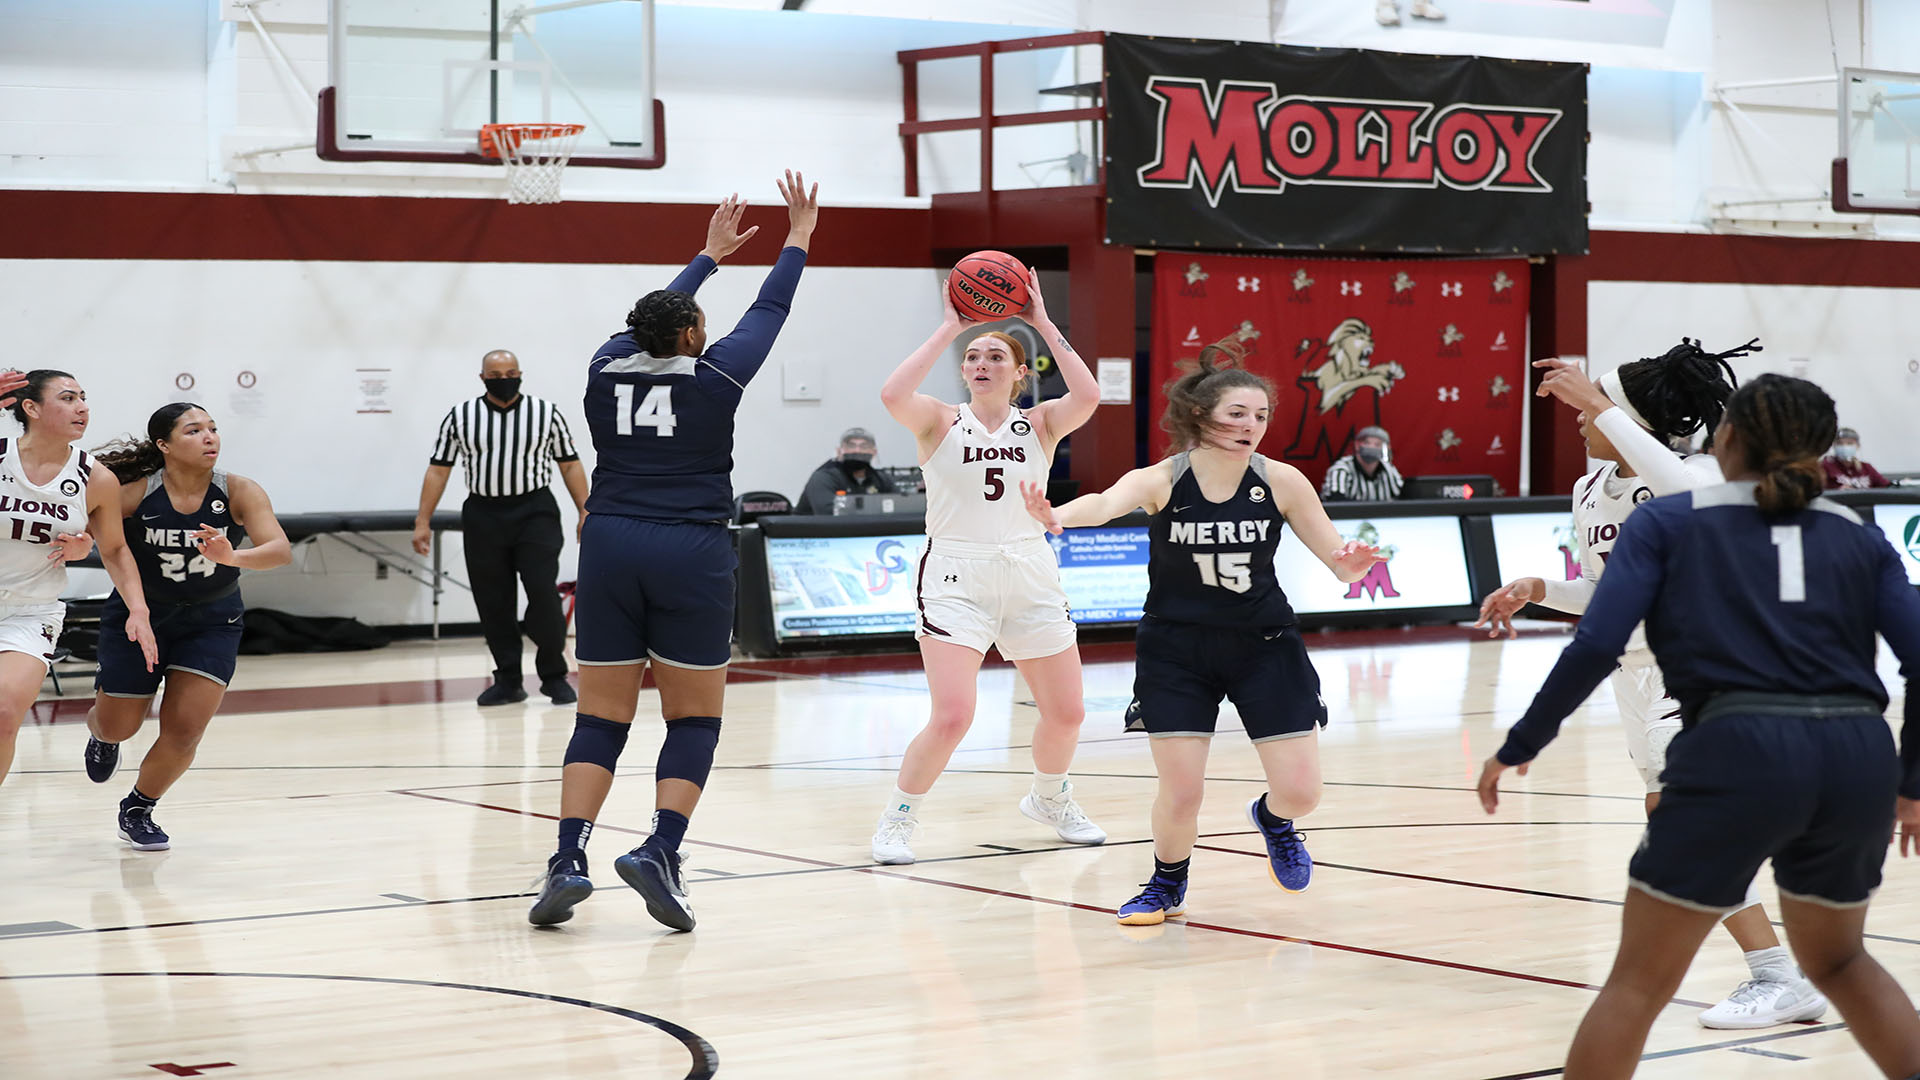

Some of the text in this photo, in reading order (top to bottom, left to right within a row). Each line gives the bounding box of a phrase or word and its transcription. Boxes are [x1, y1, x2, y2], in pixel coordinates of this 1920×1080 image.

[1137, 74, 1563, 208] MOLLOY
[976, 267, 1016, 295] NCAA
[958, 279, 1007, 315] Wilson
[614, 383, 677, 437] 14
[962, 446, 1026, 464] LIONS
[984, 467, 1005, 501] 5
[0, 495, 69, 521] LIONS
[10, 517, 52, 544] 15
[1068, 535, 1095, 545] Mercy
[1096, 533, 1128, 543] Medical
[1168, 519, 1271, 544] MERCY
[157, 552, 217, 583] 24
[1192, 552, 1252, 594] 15
[1771, 525, 1805, 602] 1
